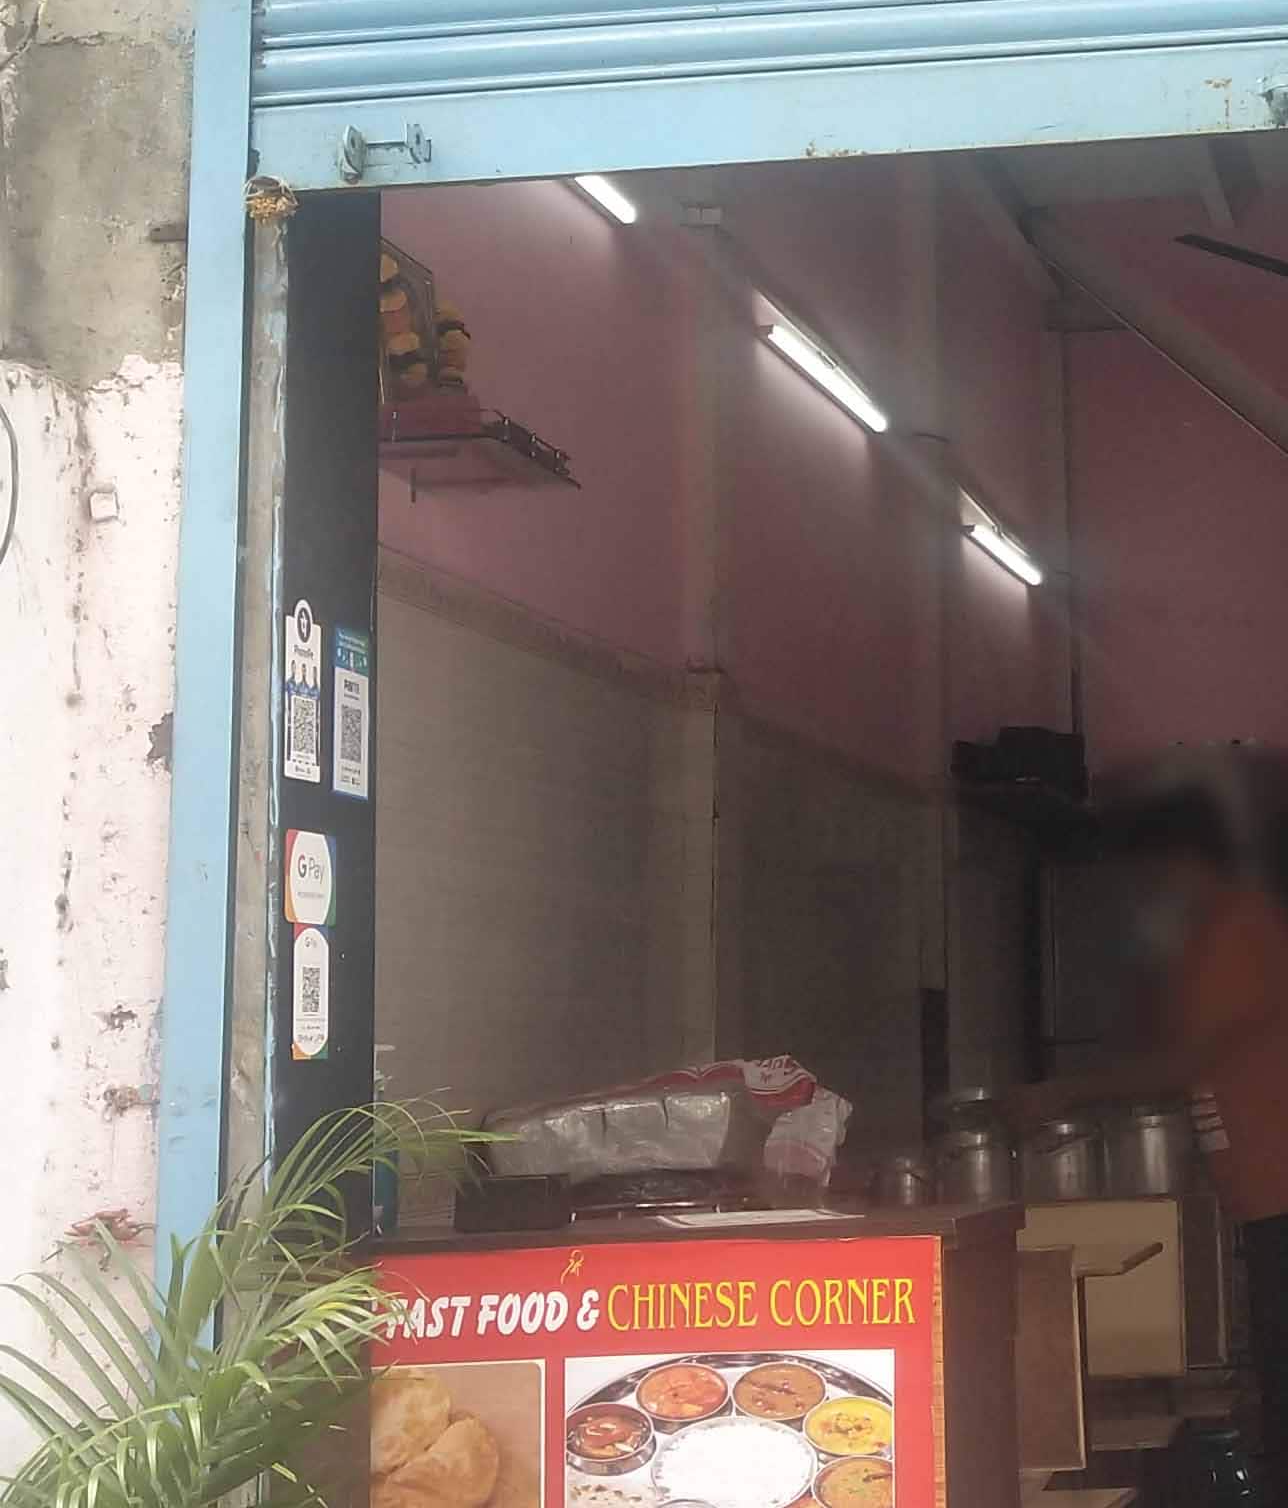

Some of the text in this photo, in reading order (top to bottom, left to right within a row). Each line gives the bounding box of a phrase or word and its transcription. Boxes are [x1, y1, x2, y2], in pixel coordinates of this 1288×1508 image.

[384, 1277, 917, 1339] FAST FOOD & CHINESE CORNER
